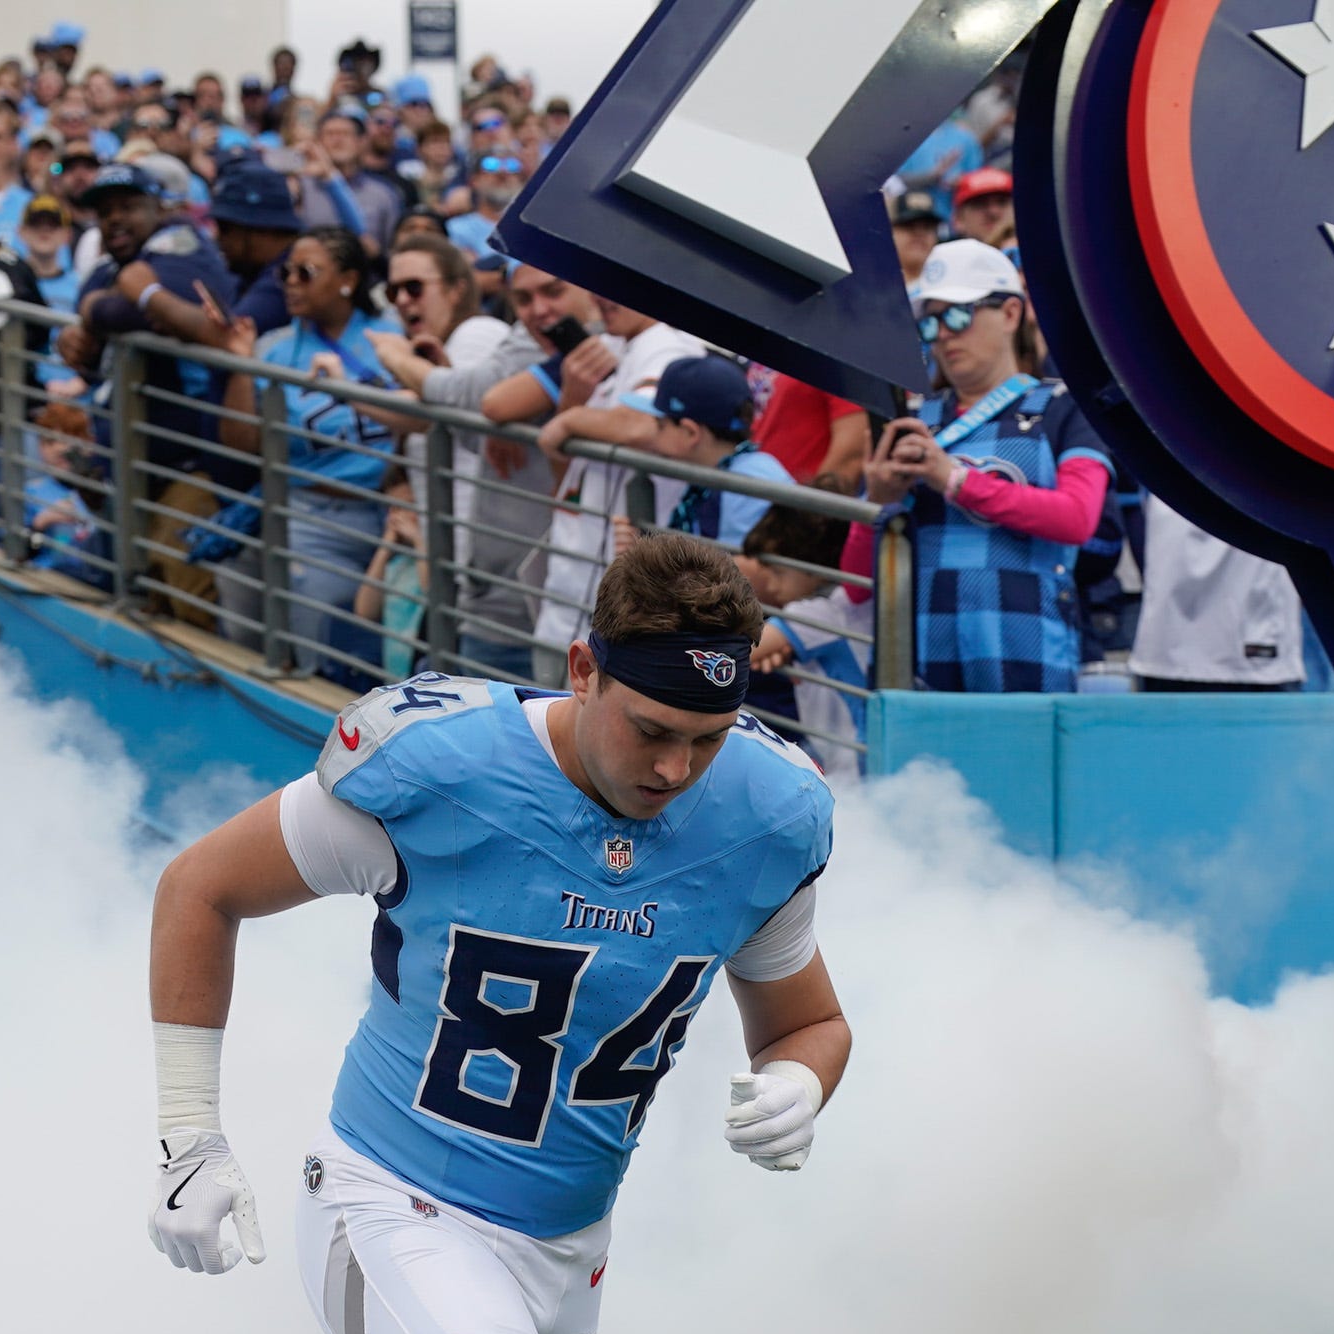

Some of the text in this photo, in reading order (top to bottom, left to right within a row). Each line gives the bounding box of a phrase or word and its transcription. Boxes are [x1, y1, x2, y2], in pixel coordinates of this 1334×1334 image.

[610, 852, 632, 868] NFL
[560, 889, 659, 939] TITANS
[412, 923, 717, 1149] 84
